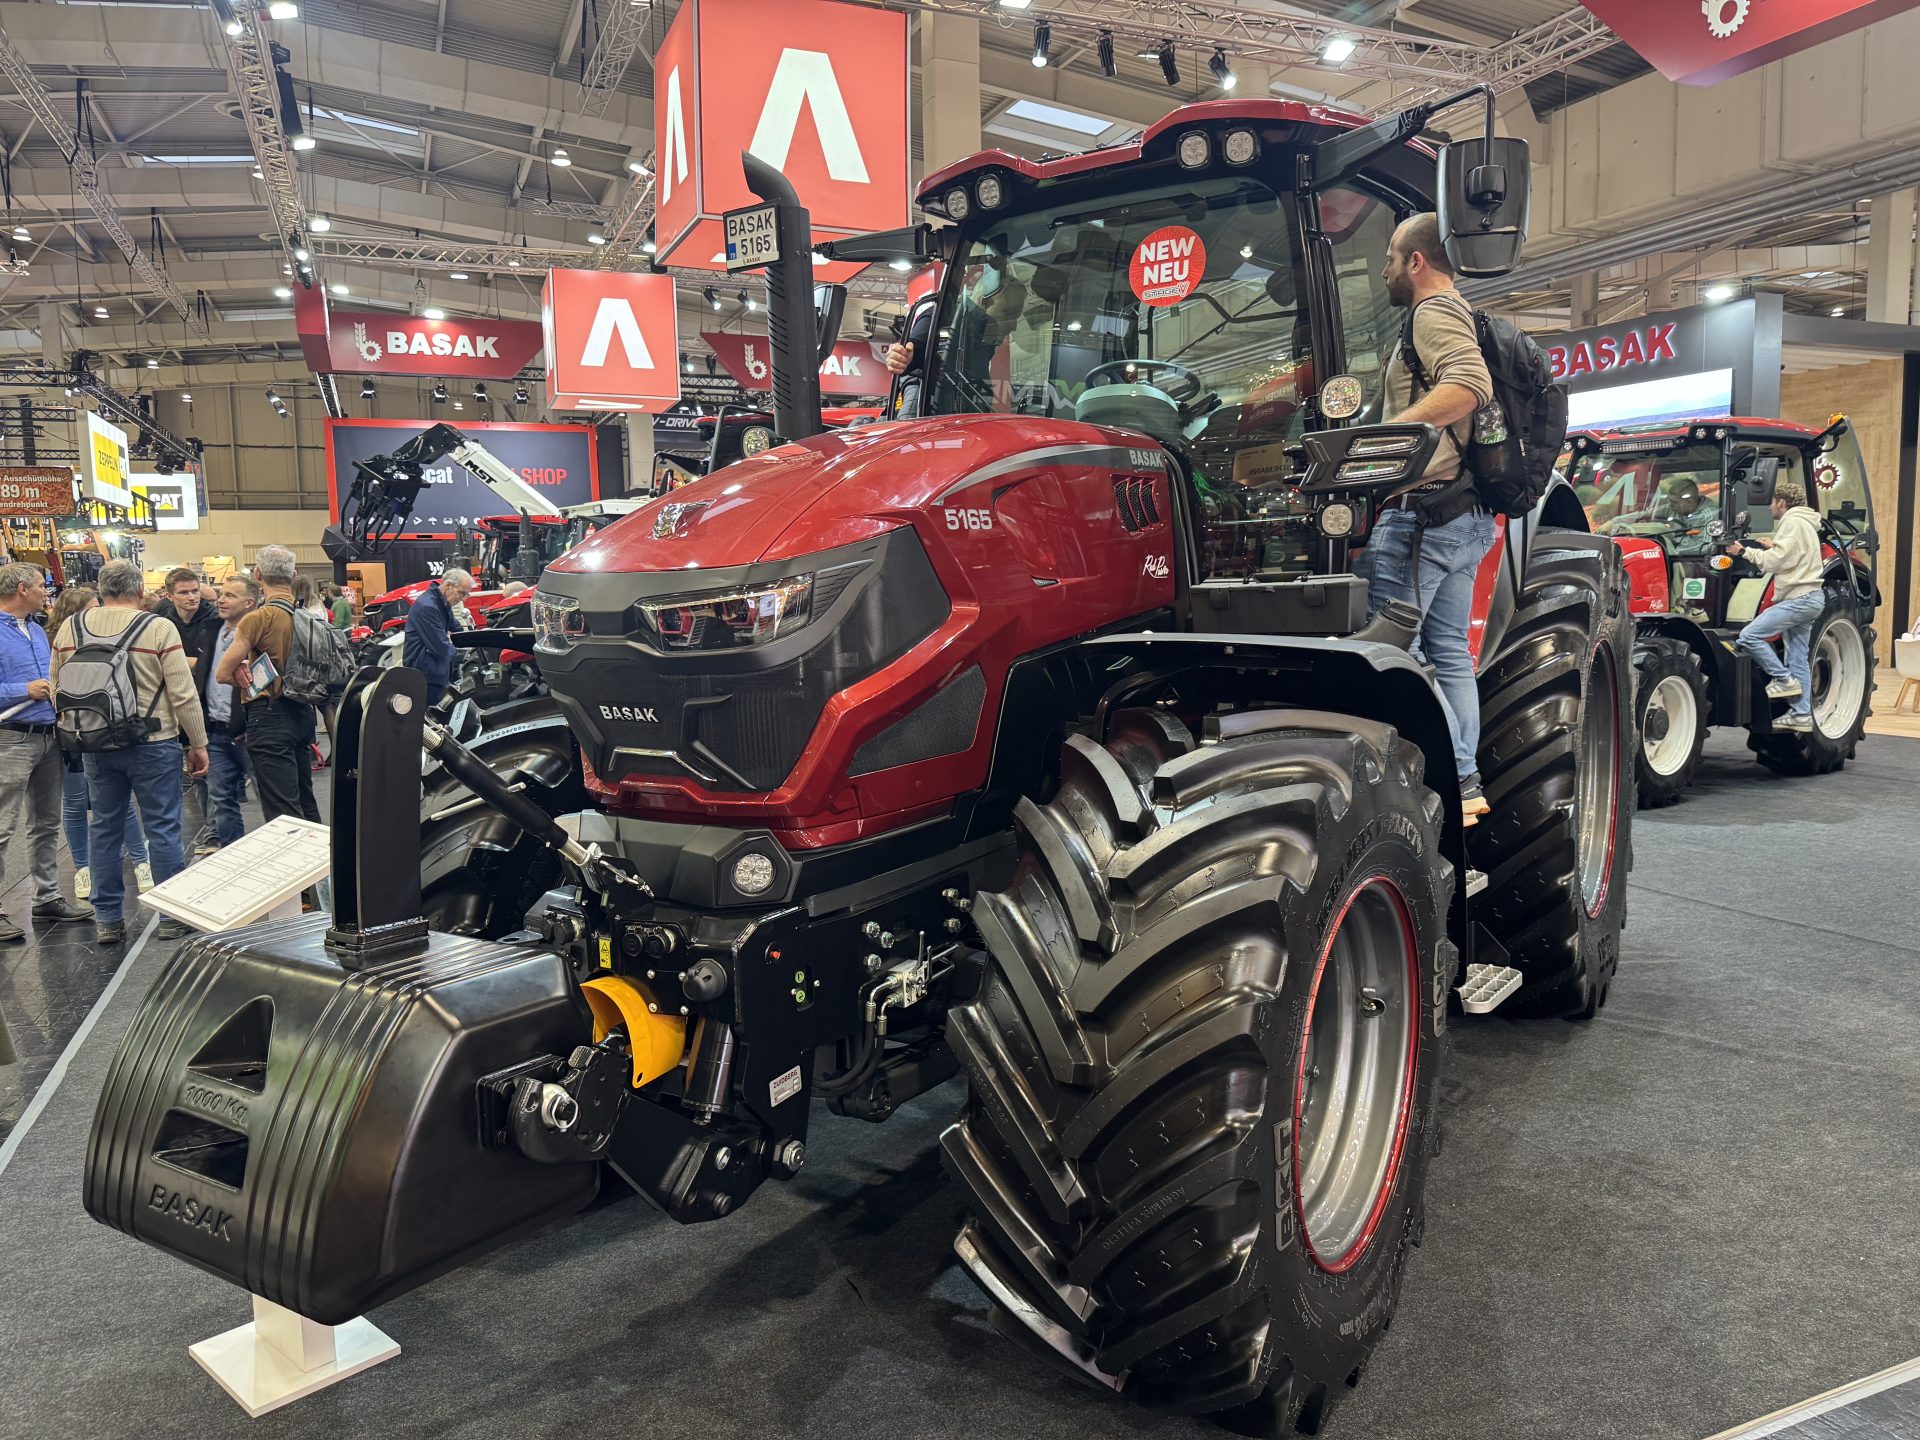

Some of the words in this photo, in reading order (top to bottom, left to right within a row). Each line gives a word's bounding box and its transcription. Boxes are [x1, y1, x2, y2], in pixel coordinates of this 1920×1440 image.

[729, 211, 773, 237] BASAK
[740, 234, 771, 255] 5165
[1140, 236, 1195, 263] NEW
[1143, 260, 1190, 286] NEU
[386, 331, 500, 358] BASAK
[1548, 323, 1676, 378] BASAK
[1129, 449, 1163, 467] BASAK
[464, 459, 498, 484] MST
[521, 467, 567, 485] SHOP
[149, 493, 183, 510] CAT
[944, 509, 993, 530] 5165
[598, 705, 660, 723] BASAK
[186, 1085, 223, 1112] 1000
[1274, 1118, 1294, 1250] BKT
[148, 1183, 234, 1243] BASAK
